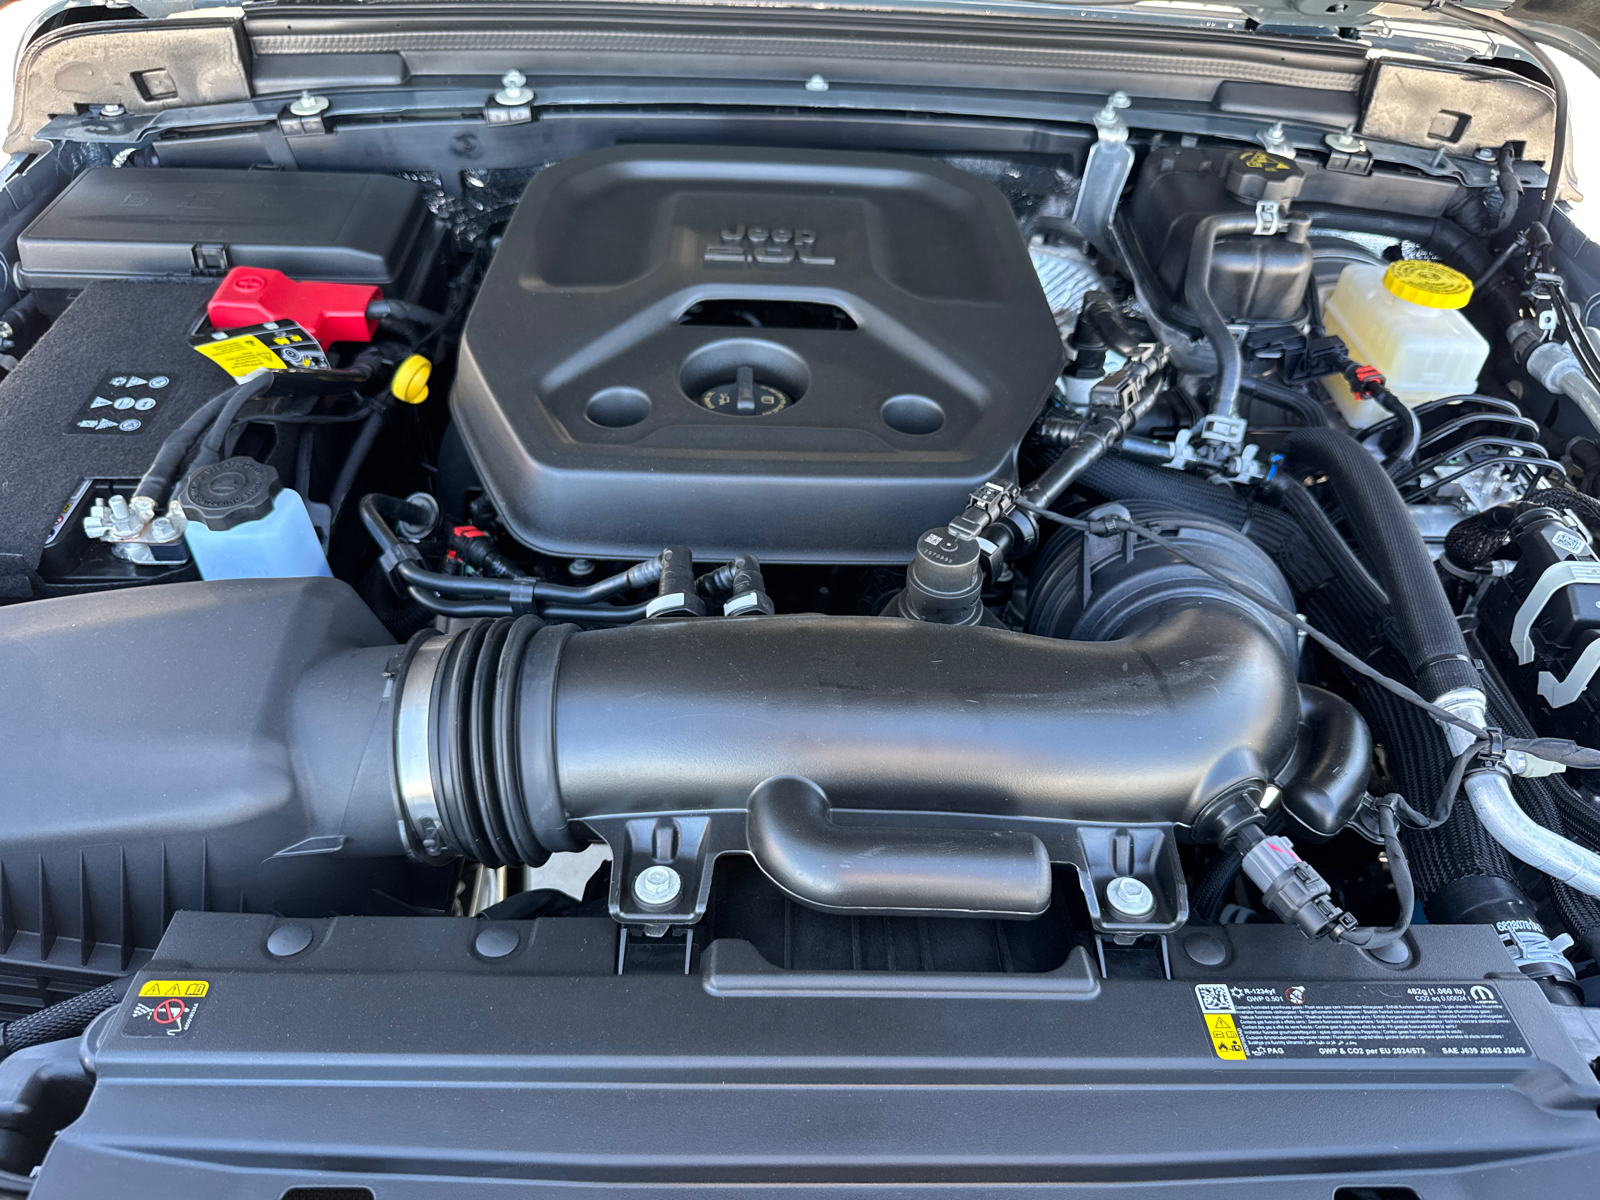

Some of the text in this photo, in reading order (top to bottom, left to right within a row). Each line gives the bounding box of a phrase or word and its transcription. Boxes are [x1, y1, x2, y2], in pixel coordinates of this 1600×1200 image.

[720, 222, 816, 246] Jeep
[704, 244, 836, 265] 2.0L
[1318, 1047, 1338, 1055] GWP
[1339, 1047, 1347, 1055] &
[1346, 1047, 1365, 1055] CO2
[1365, 1048, 1379, 1056] per
[1379, 1047, 1391, 1055] EU
